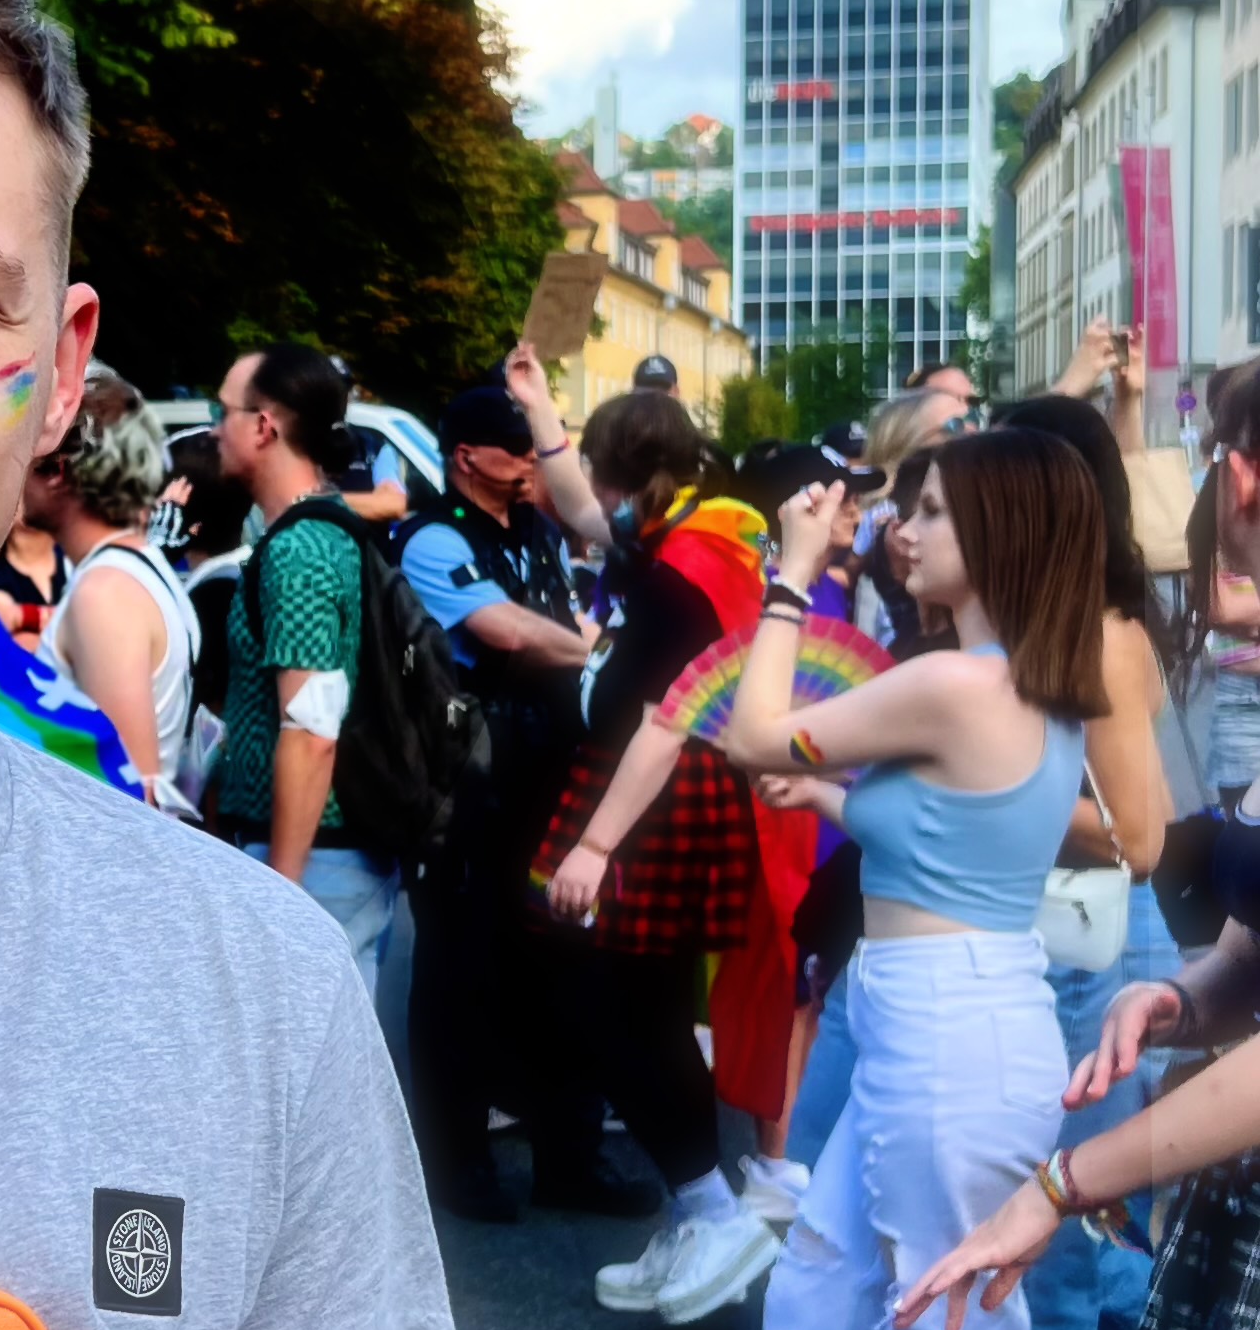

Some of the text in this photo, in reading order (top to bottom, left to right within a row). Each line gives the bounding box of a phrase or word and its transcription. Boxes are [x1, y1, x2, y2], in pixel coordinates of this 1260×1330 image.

[113, 1215, 138, 1247] STONE
[144, 1215, 167, 1252] ISLAND
[111, 1254, 136, 1290] ISLAND
[142, 1259, 166, 1292] STONE
